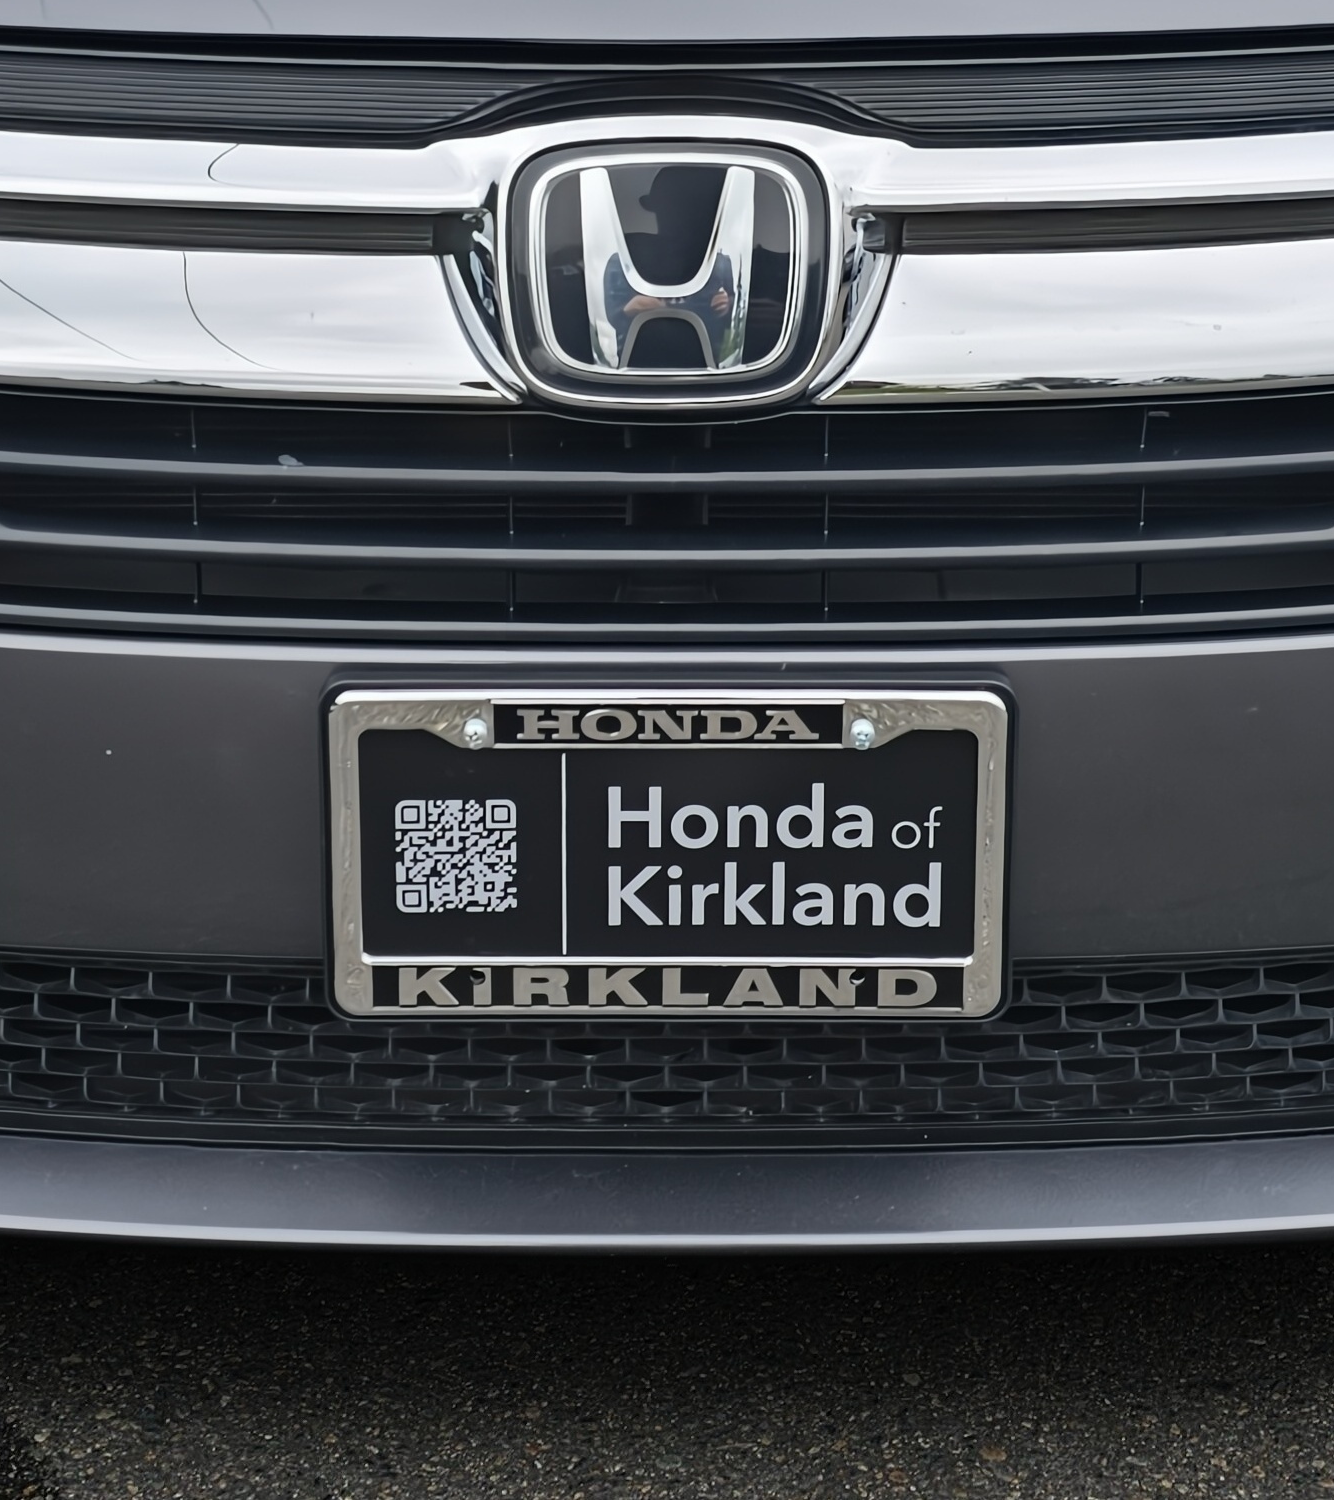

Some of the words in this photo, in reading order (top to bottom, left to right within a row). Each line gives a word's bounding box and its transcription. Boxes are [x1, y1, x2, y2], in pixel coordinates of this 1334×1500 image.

[516, 708, 819, 741] HONDA
[607, 783, 873, 849] Honda
[891, 806, 943, 849] of
[607, 861, 942, 927] Kirkland
[398, 967, 938, 1008] KIRKLAND
